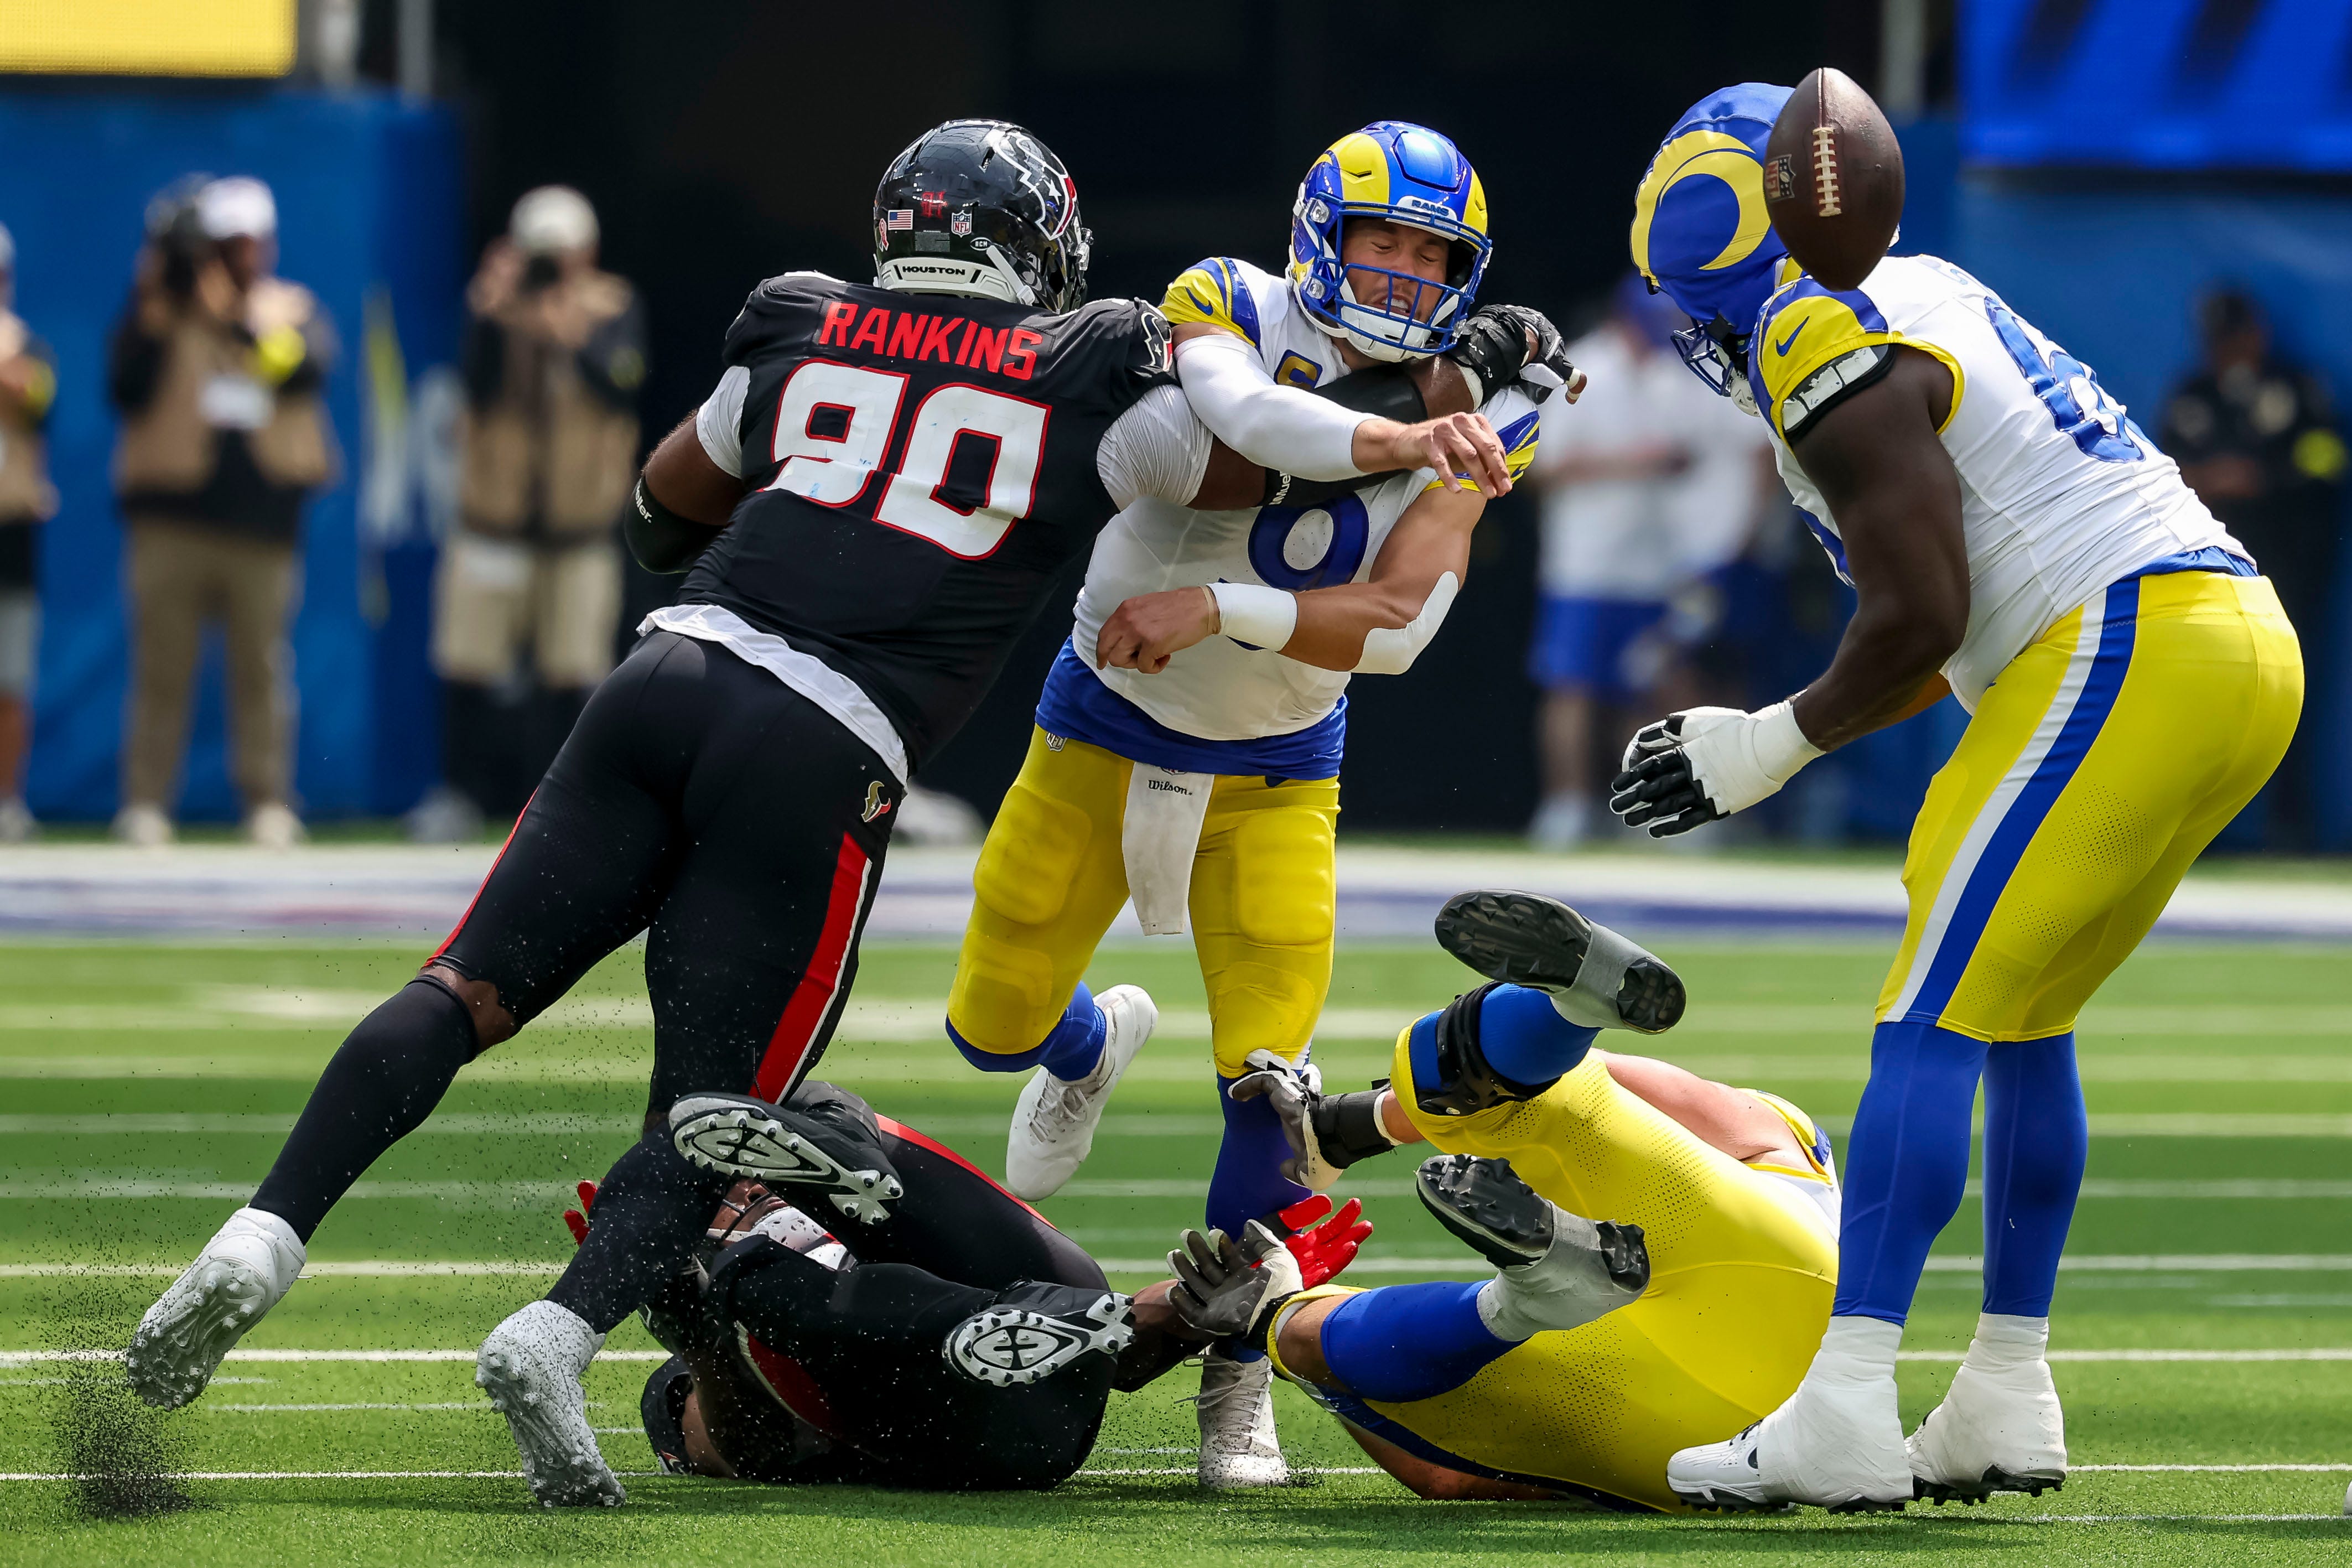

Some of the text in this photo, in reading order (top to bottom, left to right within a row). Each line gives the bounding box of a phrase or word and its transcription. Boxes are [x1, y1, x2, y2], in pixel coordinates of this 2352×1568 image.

[1411, 199, 1450, 216] RAMS
[954, 222, 969, 233] NFL
[902, 266, 965, 276] HOUSTON
[818, 302, 1043, 381] RANKINS
[756, 358, 1052, 561] 90
[1148, 779, 1188, 795] Wilson
